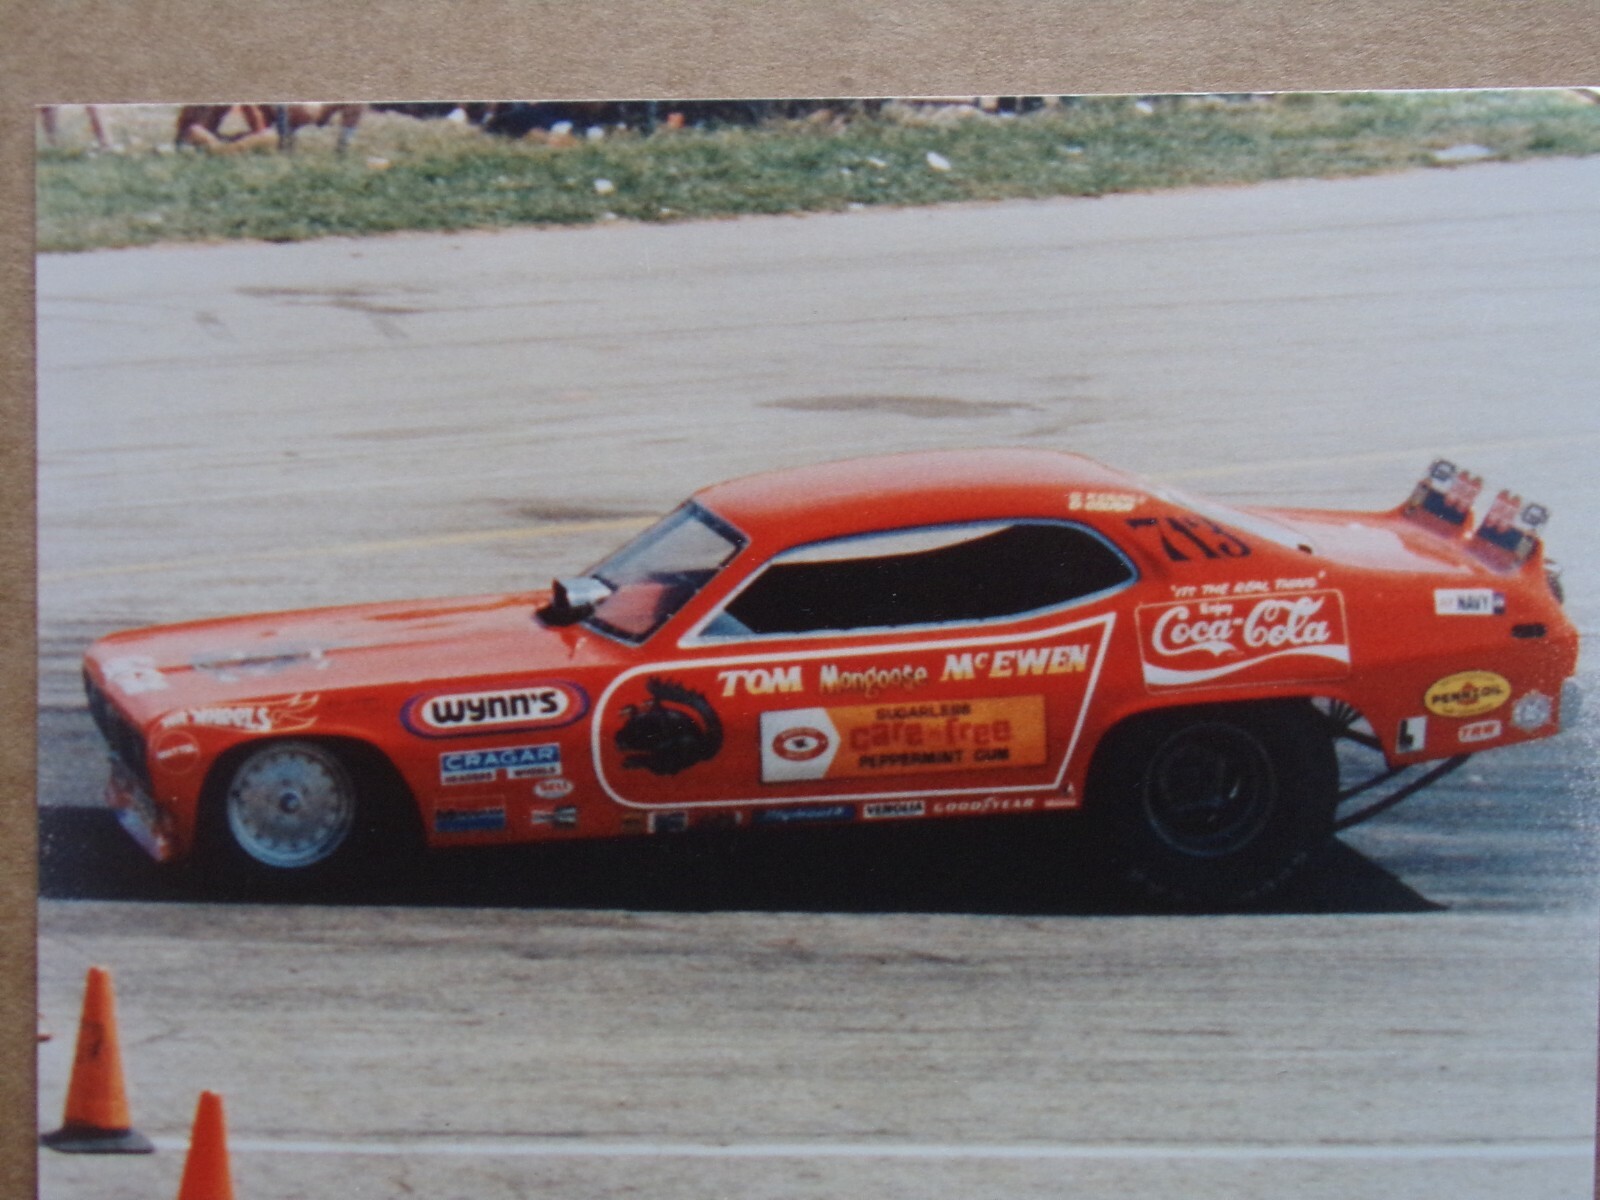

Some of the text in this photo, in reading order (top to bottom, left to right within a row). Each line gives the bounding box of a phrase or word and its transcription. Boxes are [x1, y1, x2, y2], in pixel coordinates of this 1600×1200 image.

[1126, 516, 1251, 561] 713
[1201, 582, 1229, 595] THE
[1234, 580, 1269, 593] REAL
[1457, 593, 1489, 610] NAVY
[1152, 597, 1331, 656] Coca-Cola
[717, 665, 803, 697] TOM
[819, 664, 928, 699] Mongoose
[876, 703, 971, 720] SUGARLESS
[446, 747, 554, 770] CRAGAR
[859, 748, 1010, 768] PEPPERMINT GUM
[933, 797, 1034, 813] GOODYEAR
